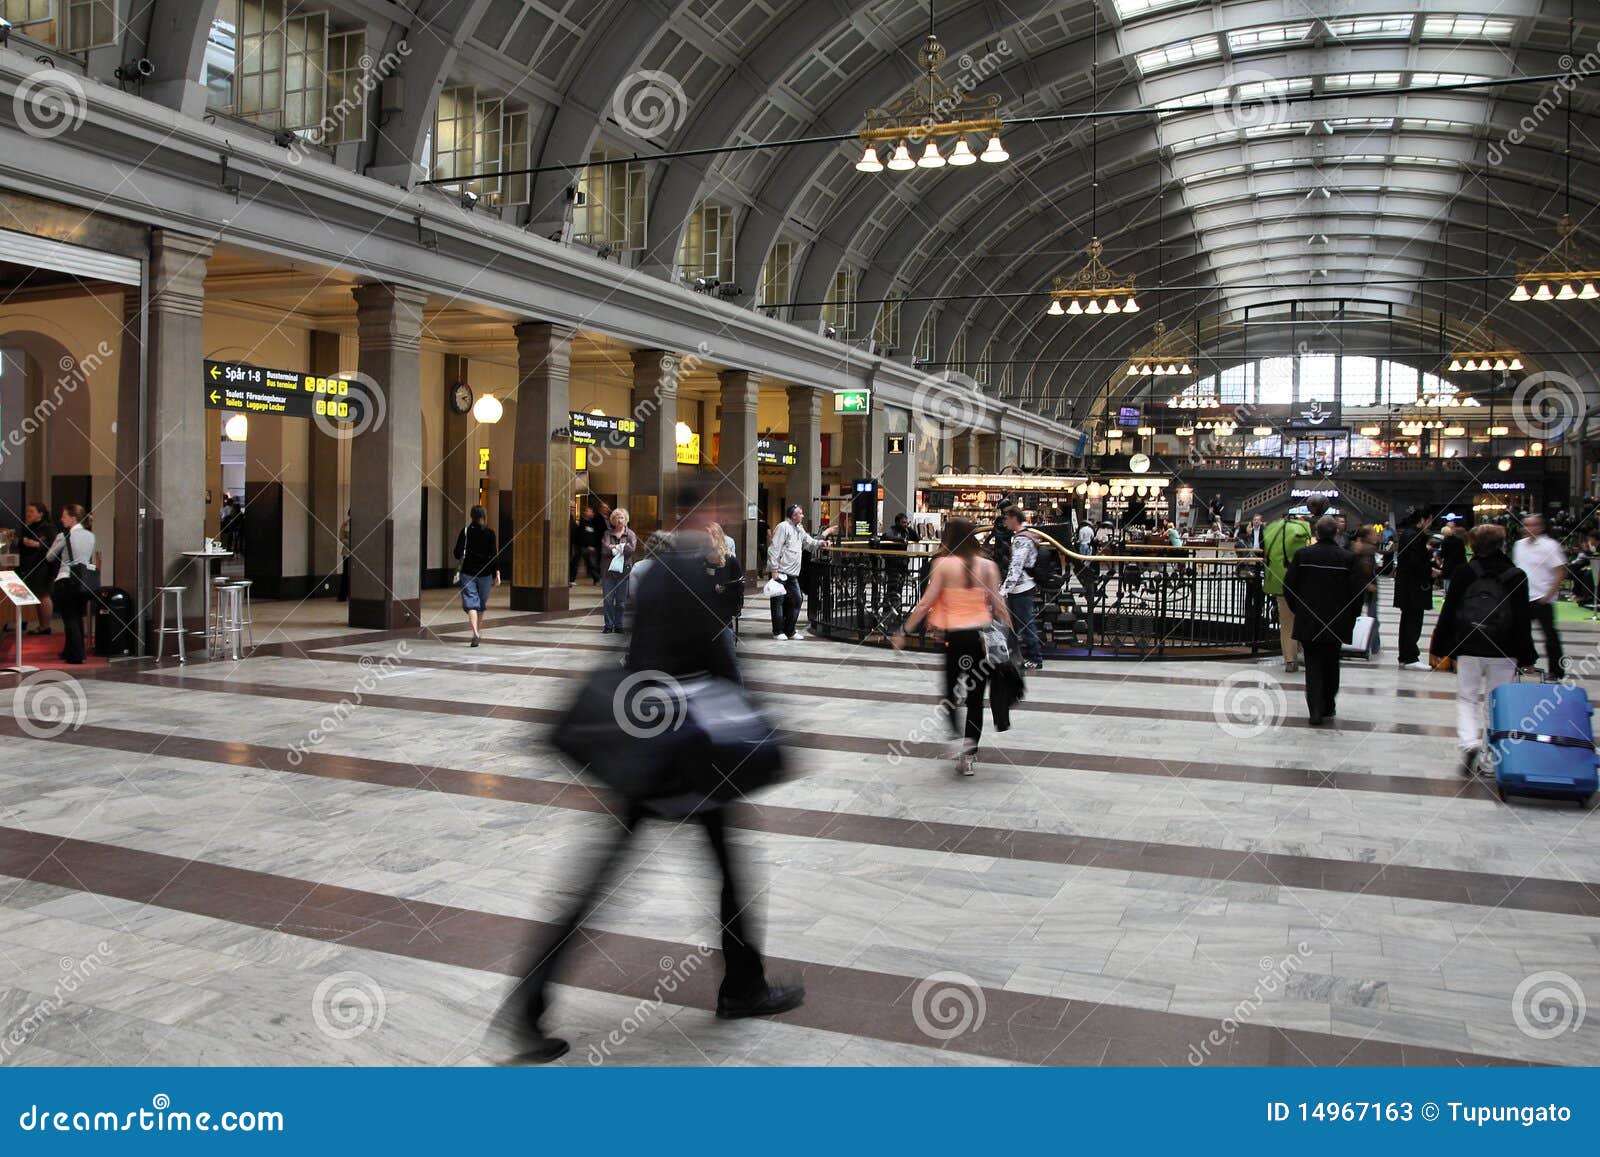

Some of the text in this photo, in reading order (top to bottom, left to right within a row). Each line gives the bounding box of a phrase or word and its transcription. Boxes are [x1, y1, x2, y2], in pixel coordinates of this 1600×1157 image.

[225, 366, 261, 382] Spår 1-8
[1310, 402, 1322, 413] SJ
